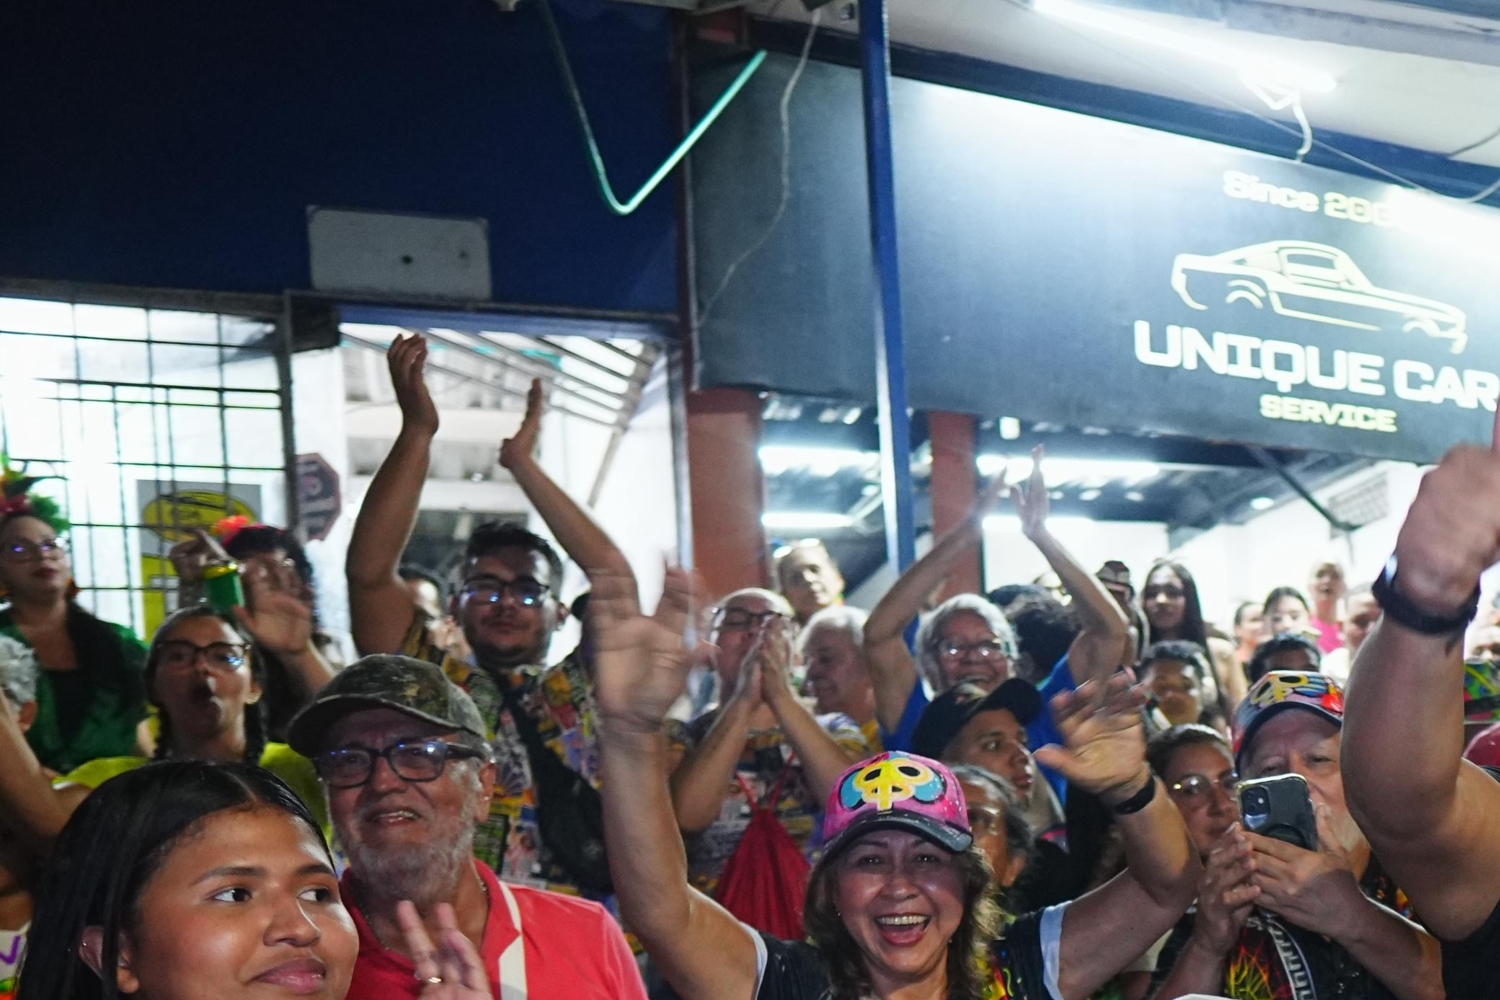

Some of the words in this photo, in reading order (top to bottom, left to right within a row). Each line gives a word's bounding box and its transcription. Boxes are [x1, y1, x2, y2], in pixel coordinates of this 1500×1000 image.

[1223, 170, 1319, 213] Since
[1133, 319, 1387, 393] UNIQUE
[1392, 360, 1500, 412] CAR
[1259, 393, 1398, 432] SERVICE
